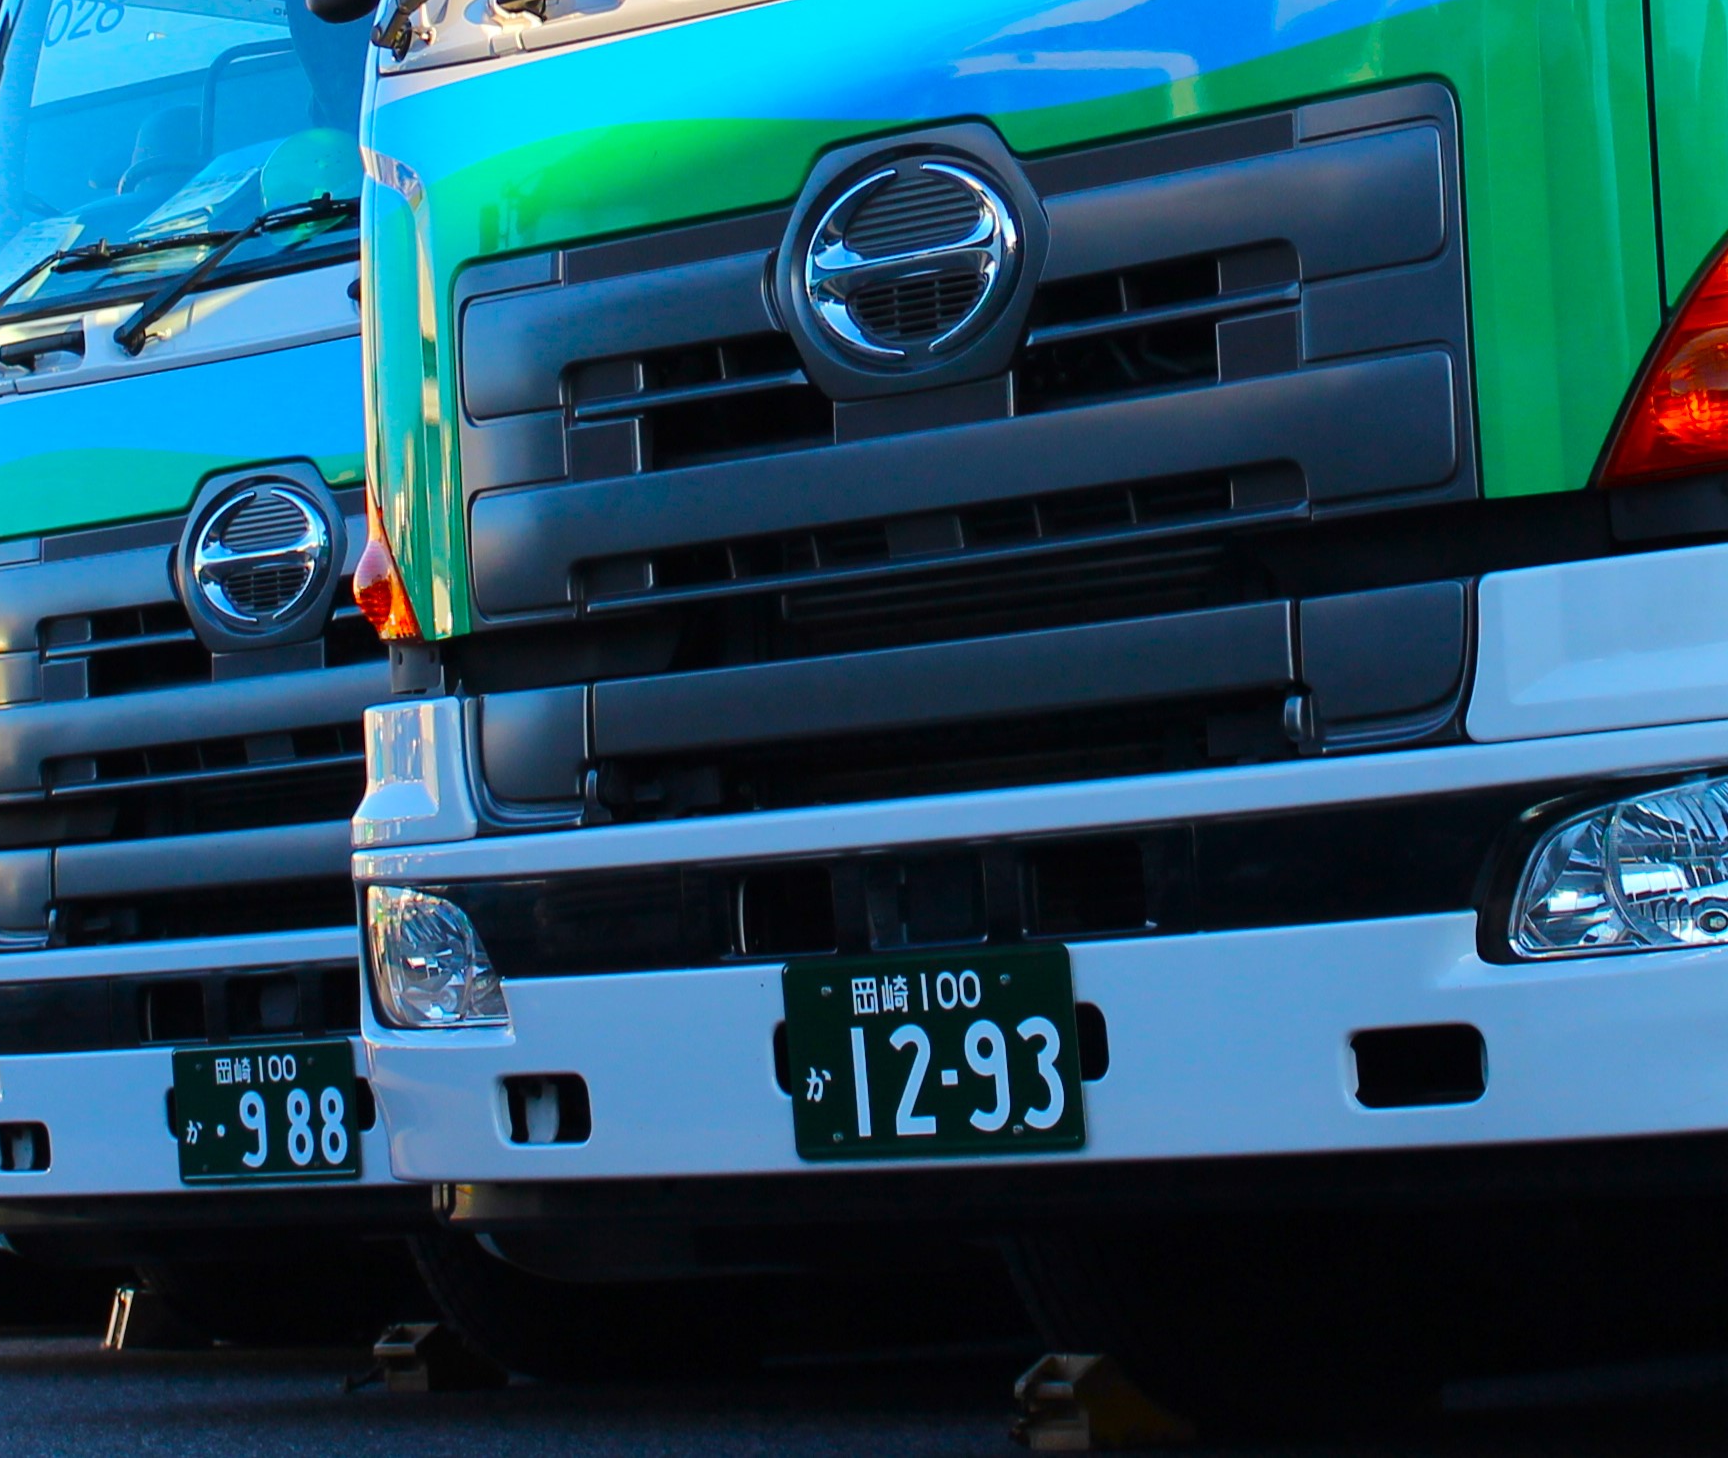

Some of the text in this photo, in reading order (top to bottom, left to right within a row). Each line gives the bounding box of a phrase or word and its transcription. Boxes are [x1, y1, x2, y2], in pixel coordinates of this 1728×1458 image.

[919, 968, 982, 1012] 100
[257, 1053, 297, 1083] 100
[806, 1015, 1065, 1138] か 12-93
[186, 1119, 203, 1145] か
